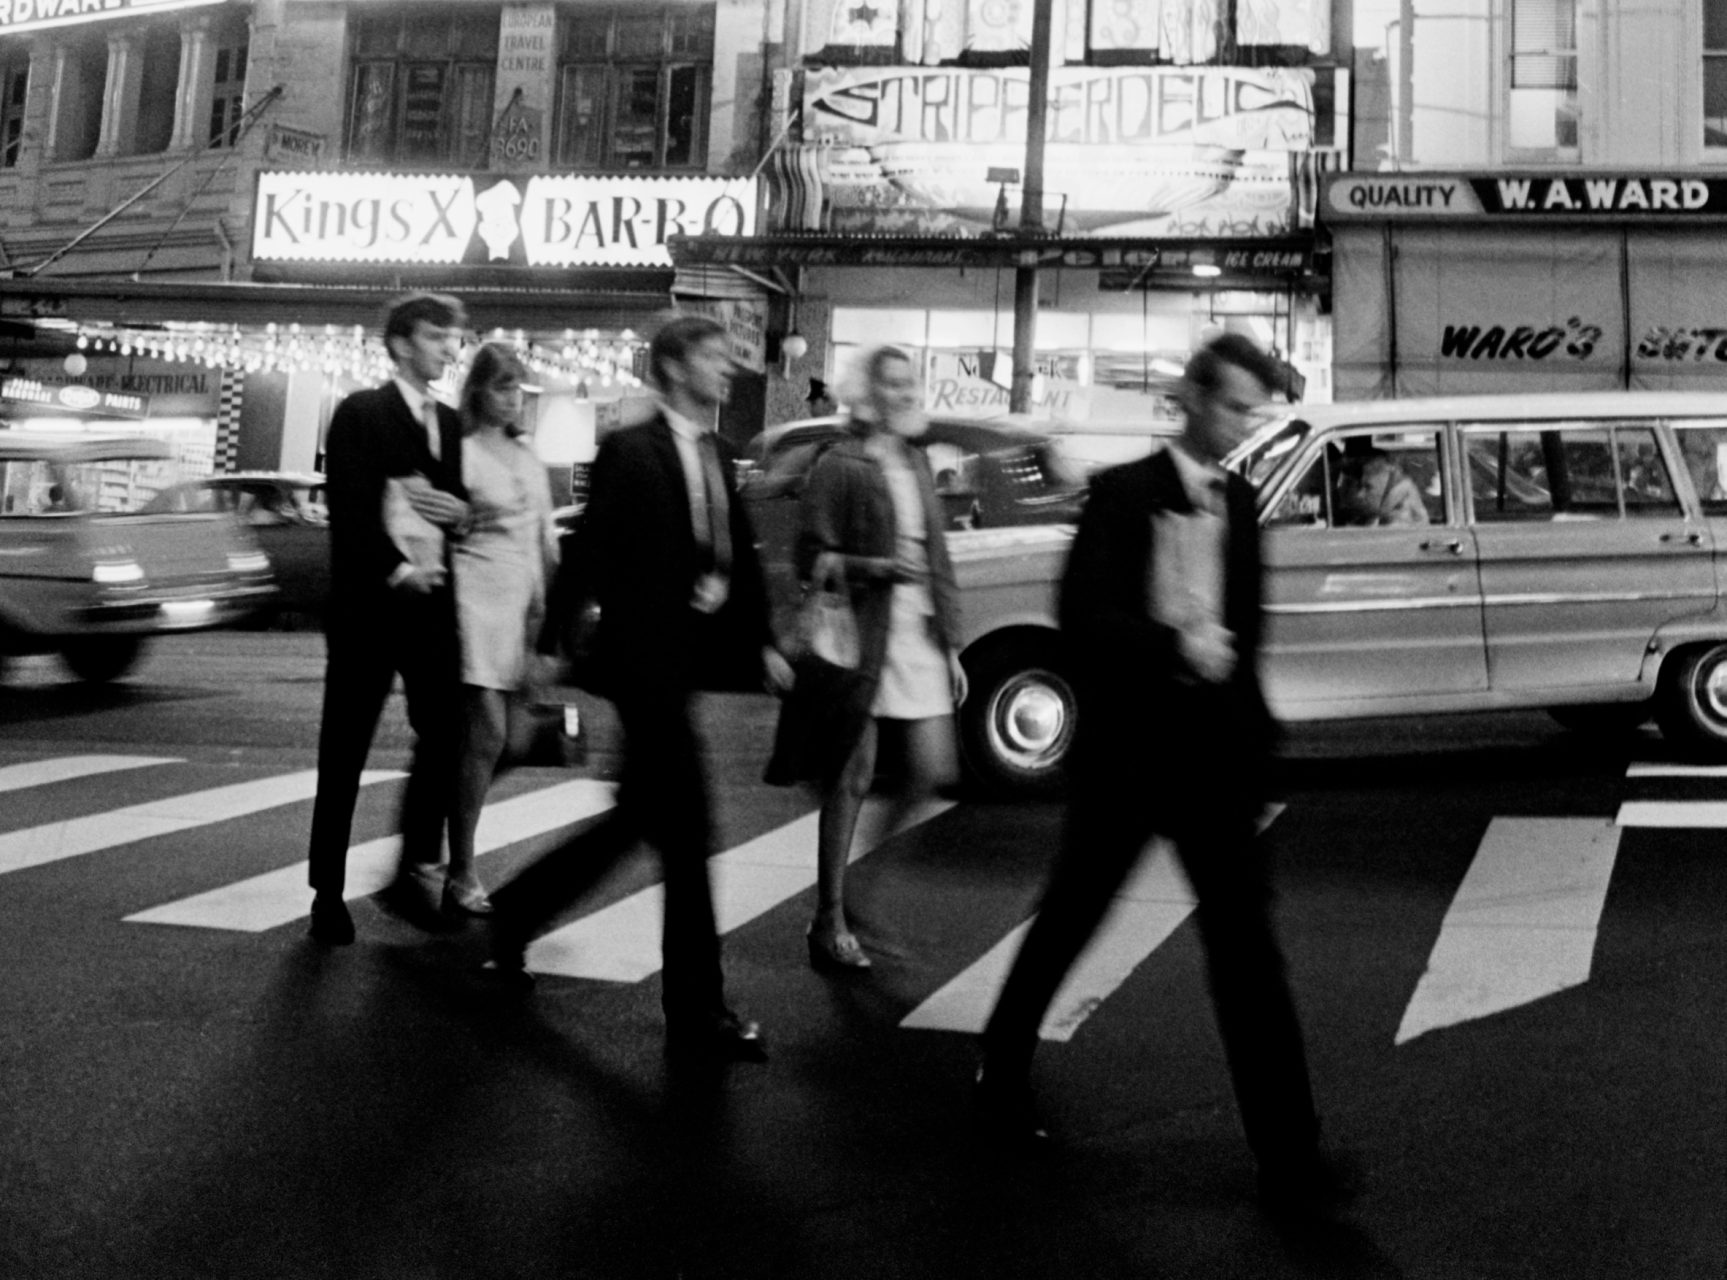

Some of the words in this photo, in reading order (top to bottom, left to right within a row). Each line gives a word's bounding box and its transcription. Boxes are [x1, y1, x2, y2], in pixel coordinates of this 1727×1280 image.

[504, 35, 545, 50] TRAVEL
[501, 57, 545, 71] CENTRE
[1349, 184, 1456, 207] QUALITY
[1224, 251, 1249, 267] ICE
[1253, 251, 1304, 267] CREAM
[929, 378, 1073, 410] RESTANT
